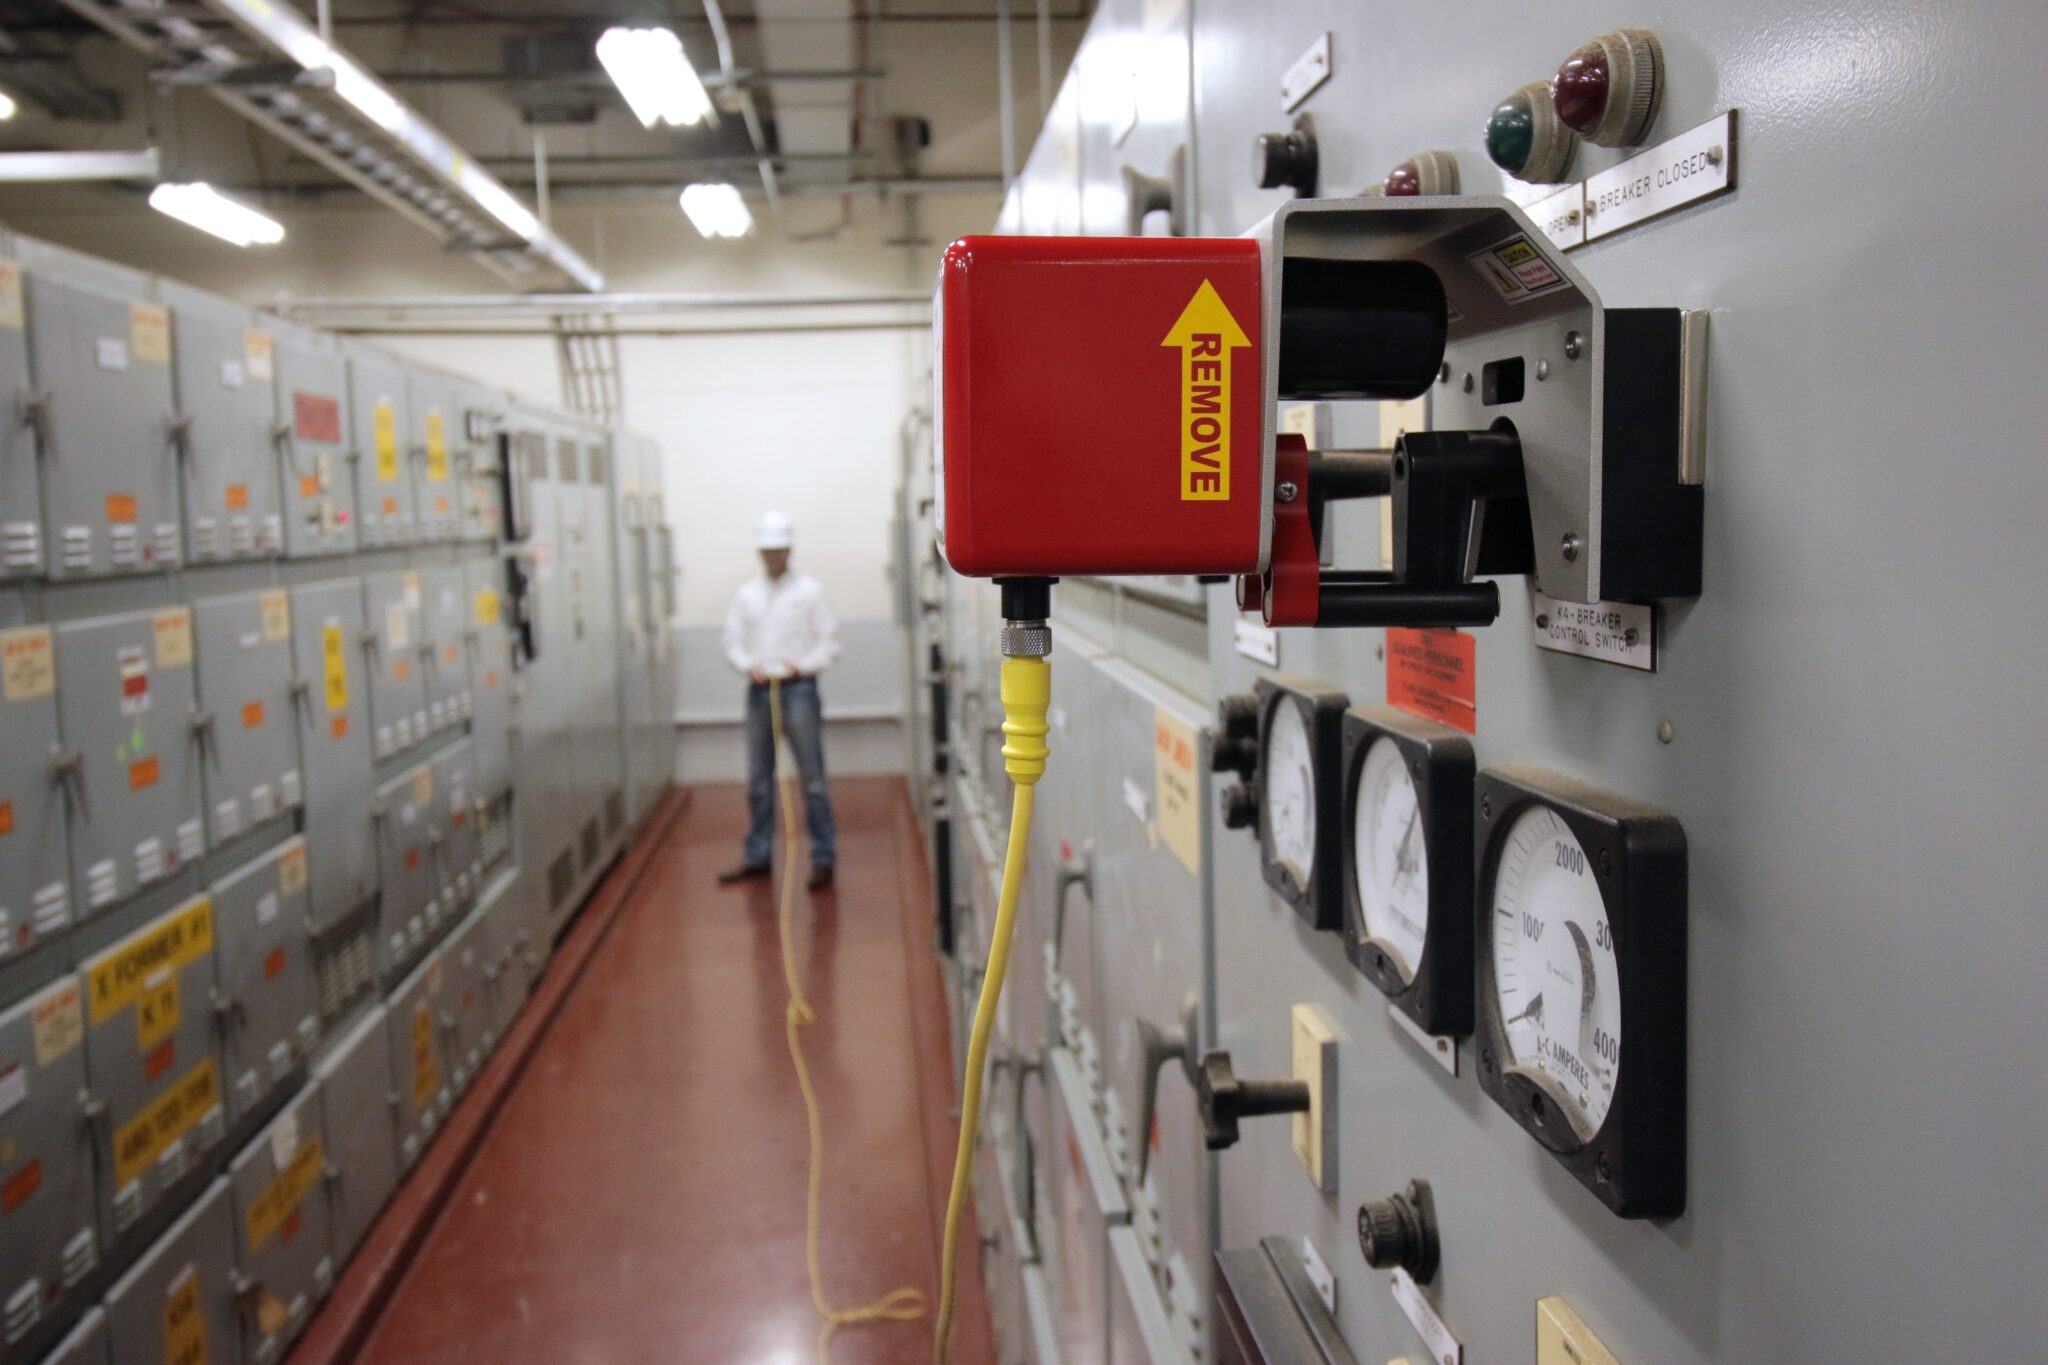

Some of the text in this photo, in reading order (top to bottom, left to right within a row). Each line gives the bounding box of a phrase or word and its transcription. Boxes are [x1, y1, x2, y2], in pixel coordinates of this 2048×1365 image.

[1600, 151, 1707, 212] BREAKER CLOSED
[1190, 333, 1222, 493] REMOVE
[1549, 624, 1589, 646] CONTROL
[1555, 840, 1584, 876] 2000
[1596, 919, 1612, 952] 30
[1537, 1035, 1590, 1091] A-C AMPERES
[1593, 1027, 1619, 1066] 400
